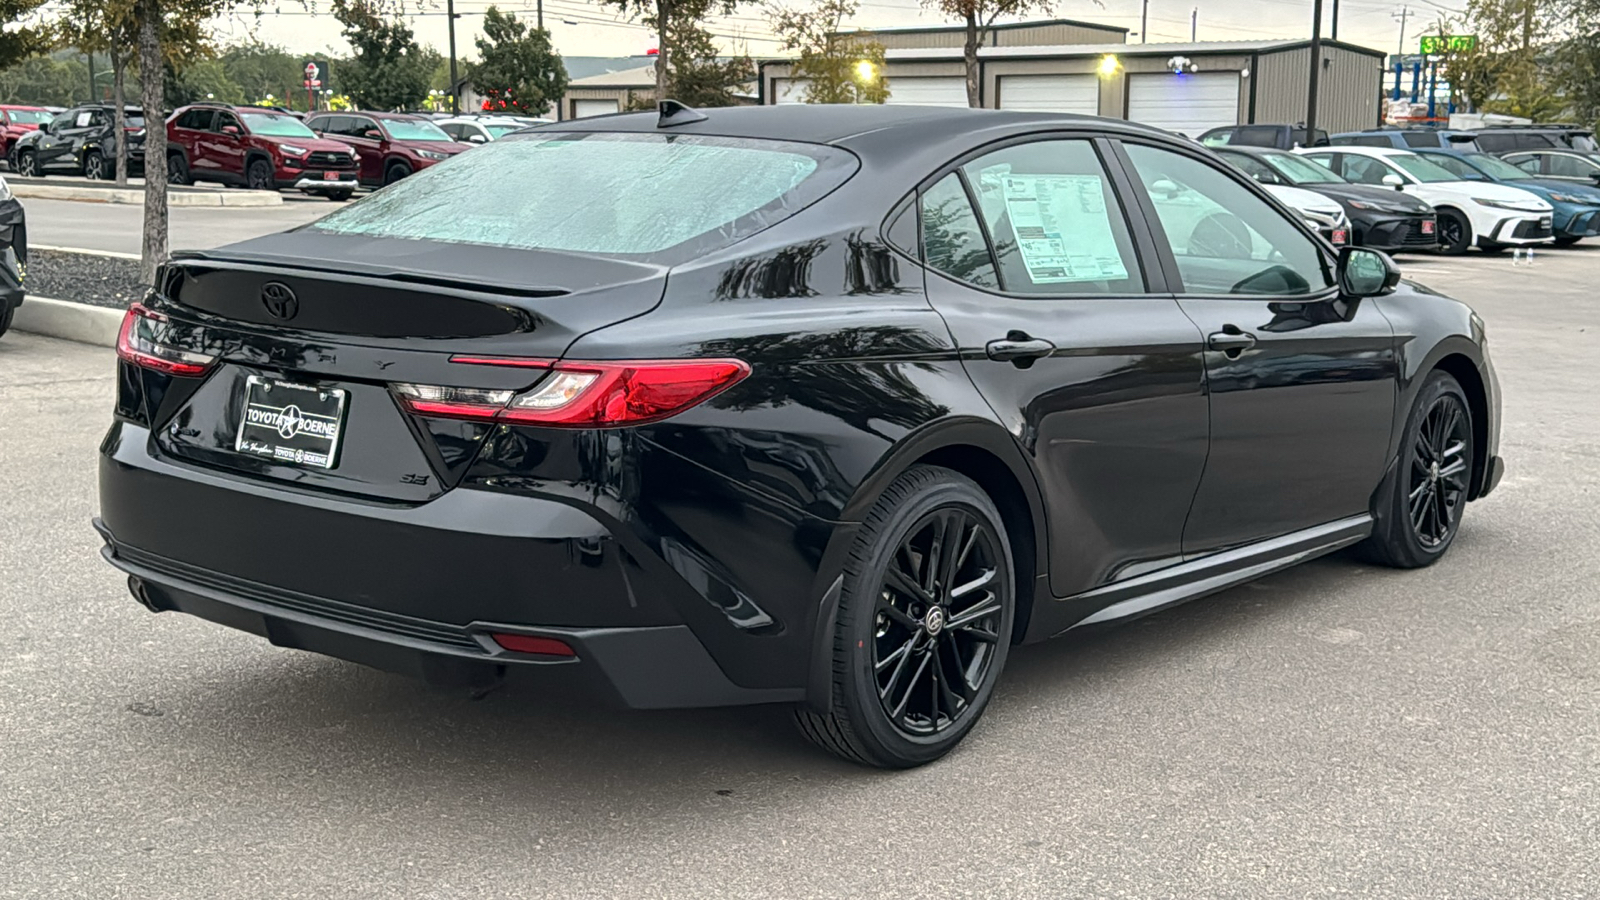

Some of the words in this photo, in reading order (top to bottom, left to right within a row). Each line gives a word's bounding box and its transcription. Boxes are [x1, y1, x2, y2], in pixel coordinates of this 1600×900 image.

[247, 408, 283, 426] TOYOTA
[298, 417, 336, 436] BOERNE
[274, 448, 295, 459] TOYOTA
[303, 454, 327, 465] BOERNE
[399, 473, 430, 486] SE
